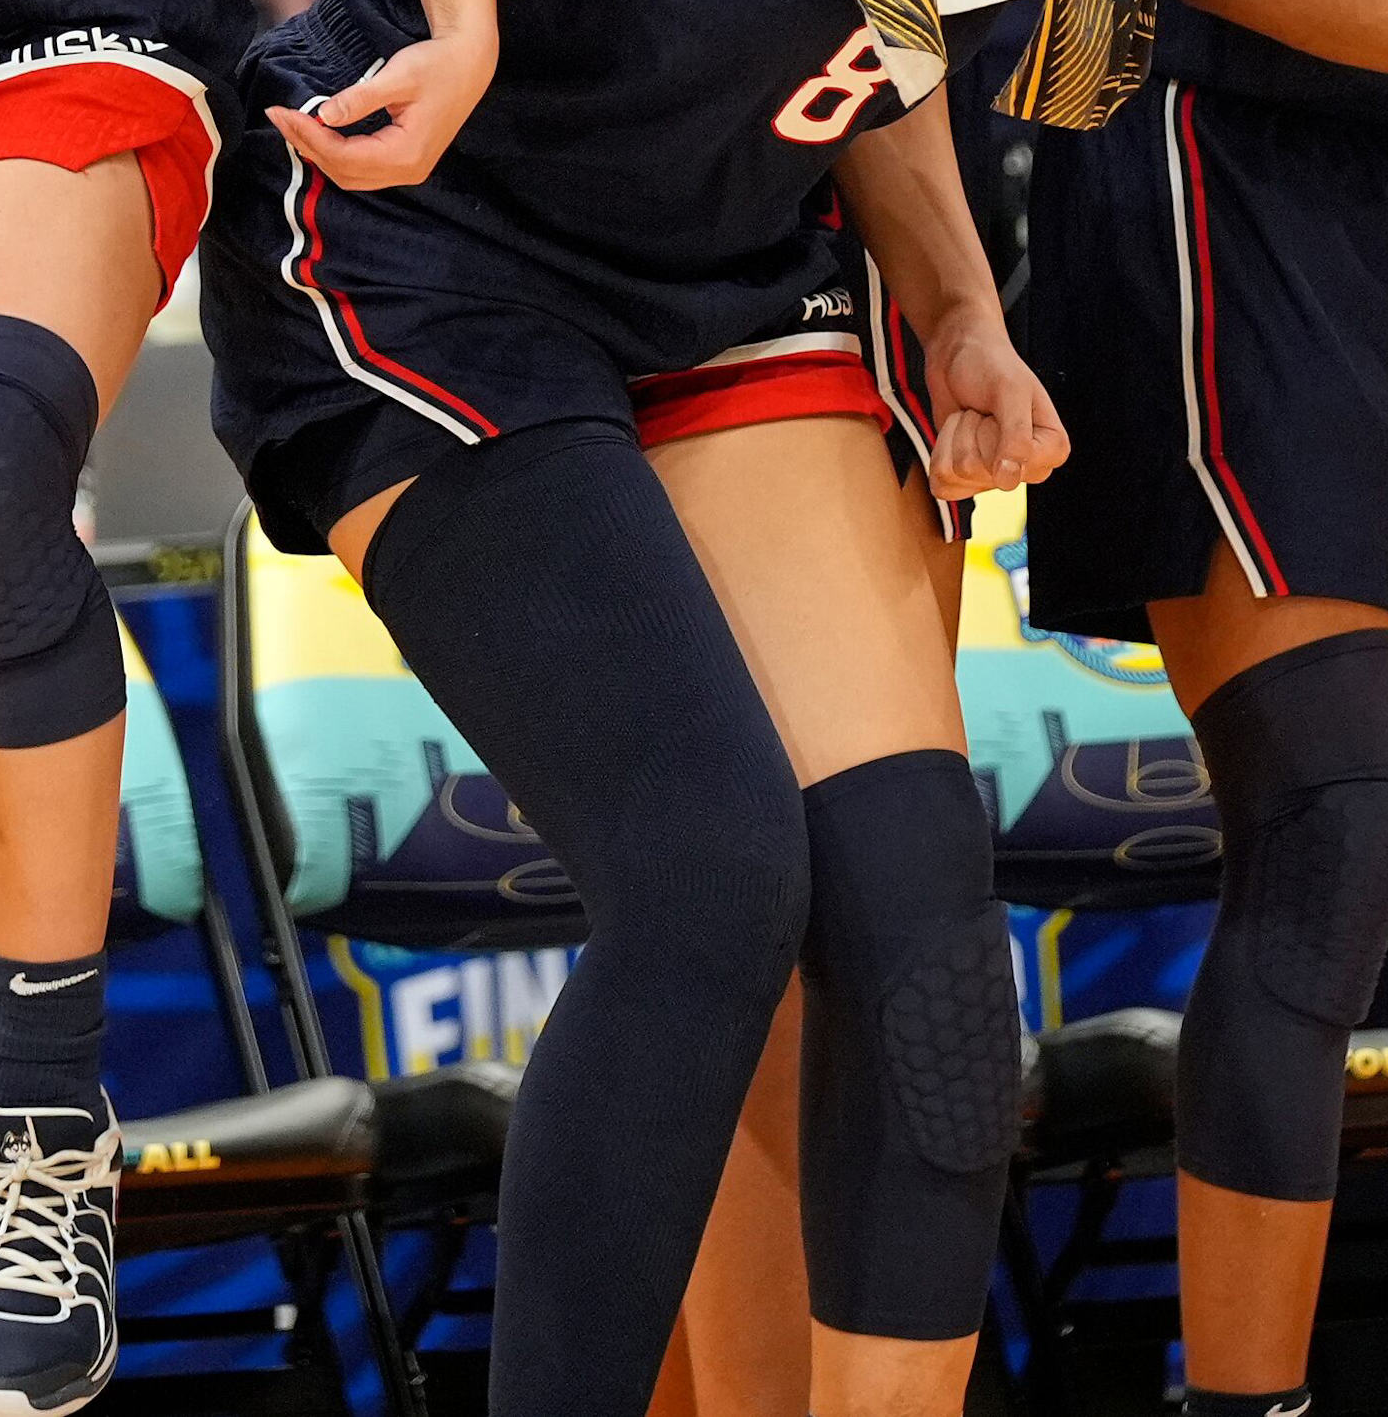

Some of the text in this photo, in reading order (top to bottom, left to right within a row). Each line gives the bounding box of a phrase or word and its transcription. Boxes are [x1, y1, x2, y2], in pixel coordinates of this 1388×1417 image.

[771, 24, 889, 144] 8
[391, 946, 568, 1077] FIN
[136, 1139, 221, 1174] ALL
